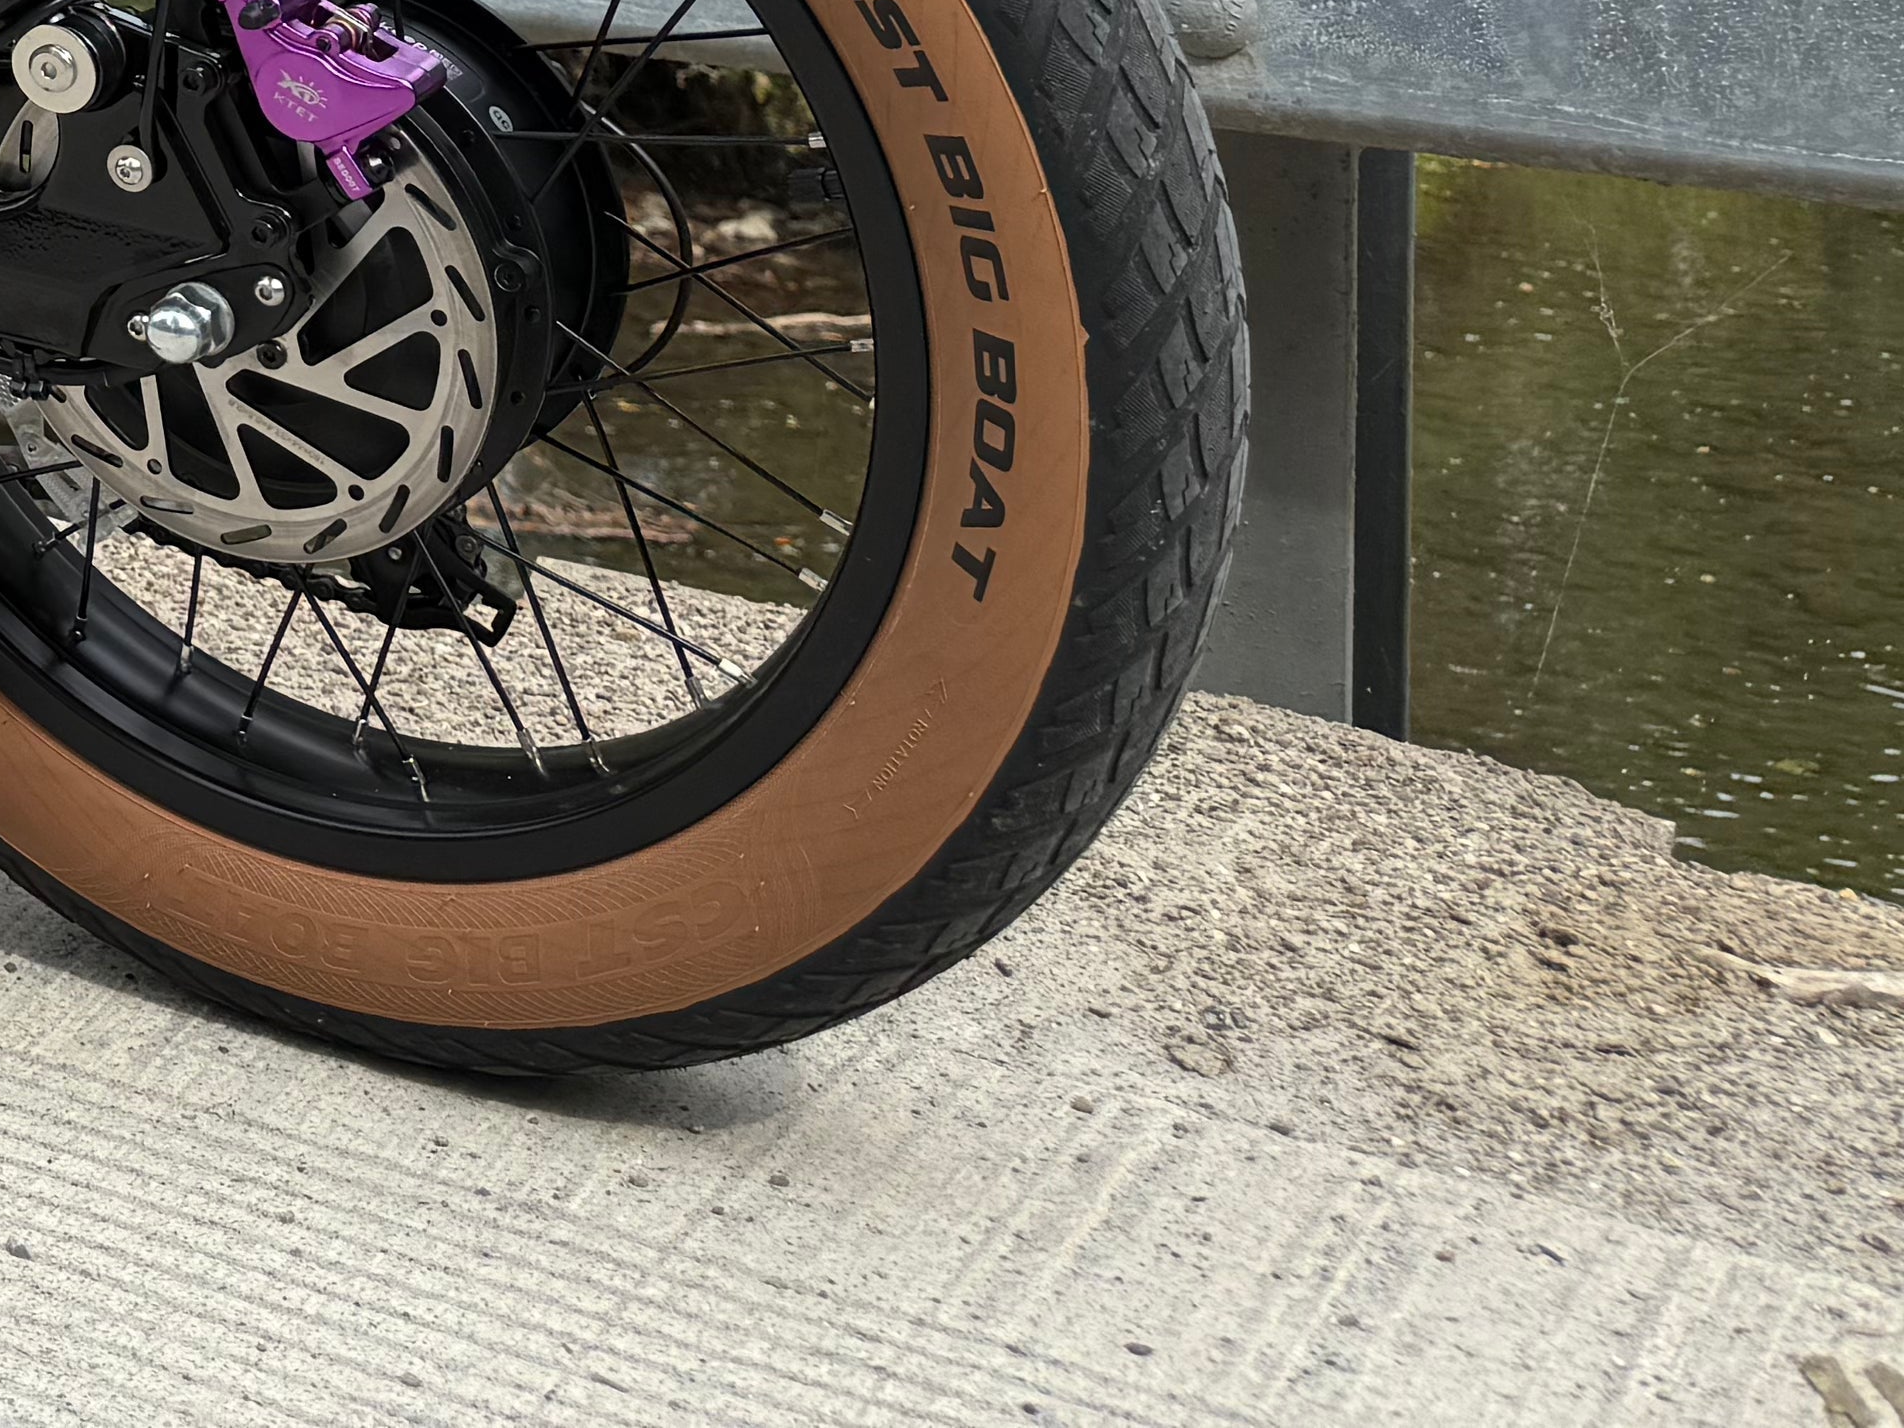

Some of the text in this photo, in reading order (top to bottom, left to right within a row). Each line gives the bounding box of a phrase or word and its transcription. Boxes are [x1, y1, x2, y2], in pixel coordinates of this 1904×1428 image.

[272, 90, 320, 124] KTET
[923, 132, 1010, 303] BIG
[950, 327, 1017, 604] BOAT
[871, 718, 930, 792] ROTATION
[407, 931, 544, 988] BIG
[574, 880, 749, 980] CST
